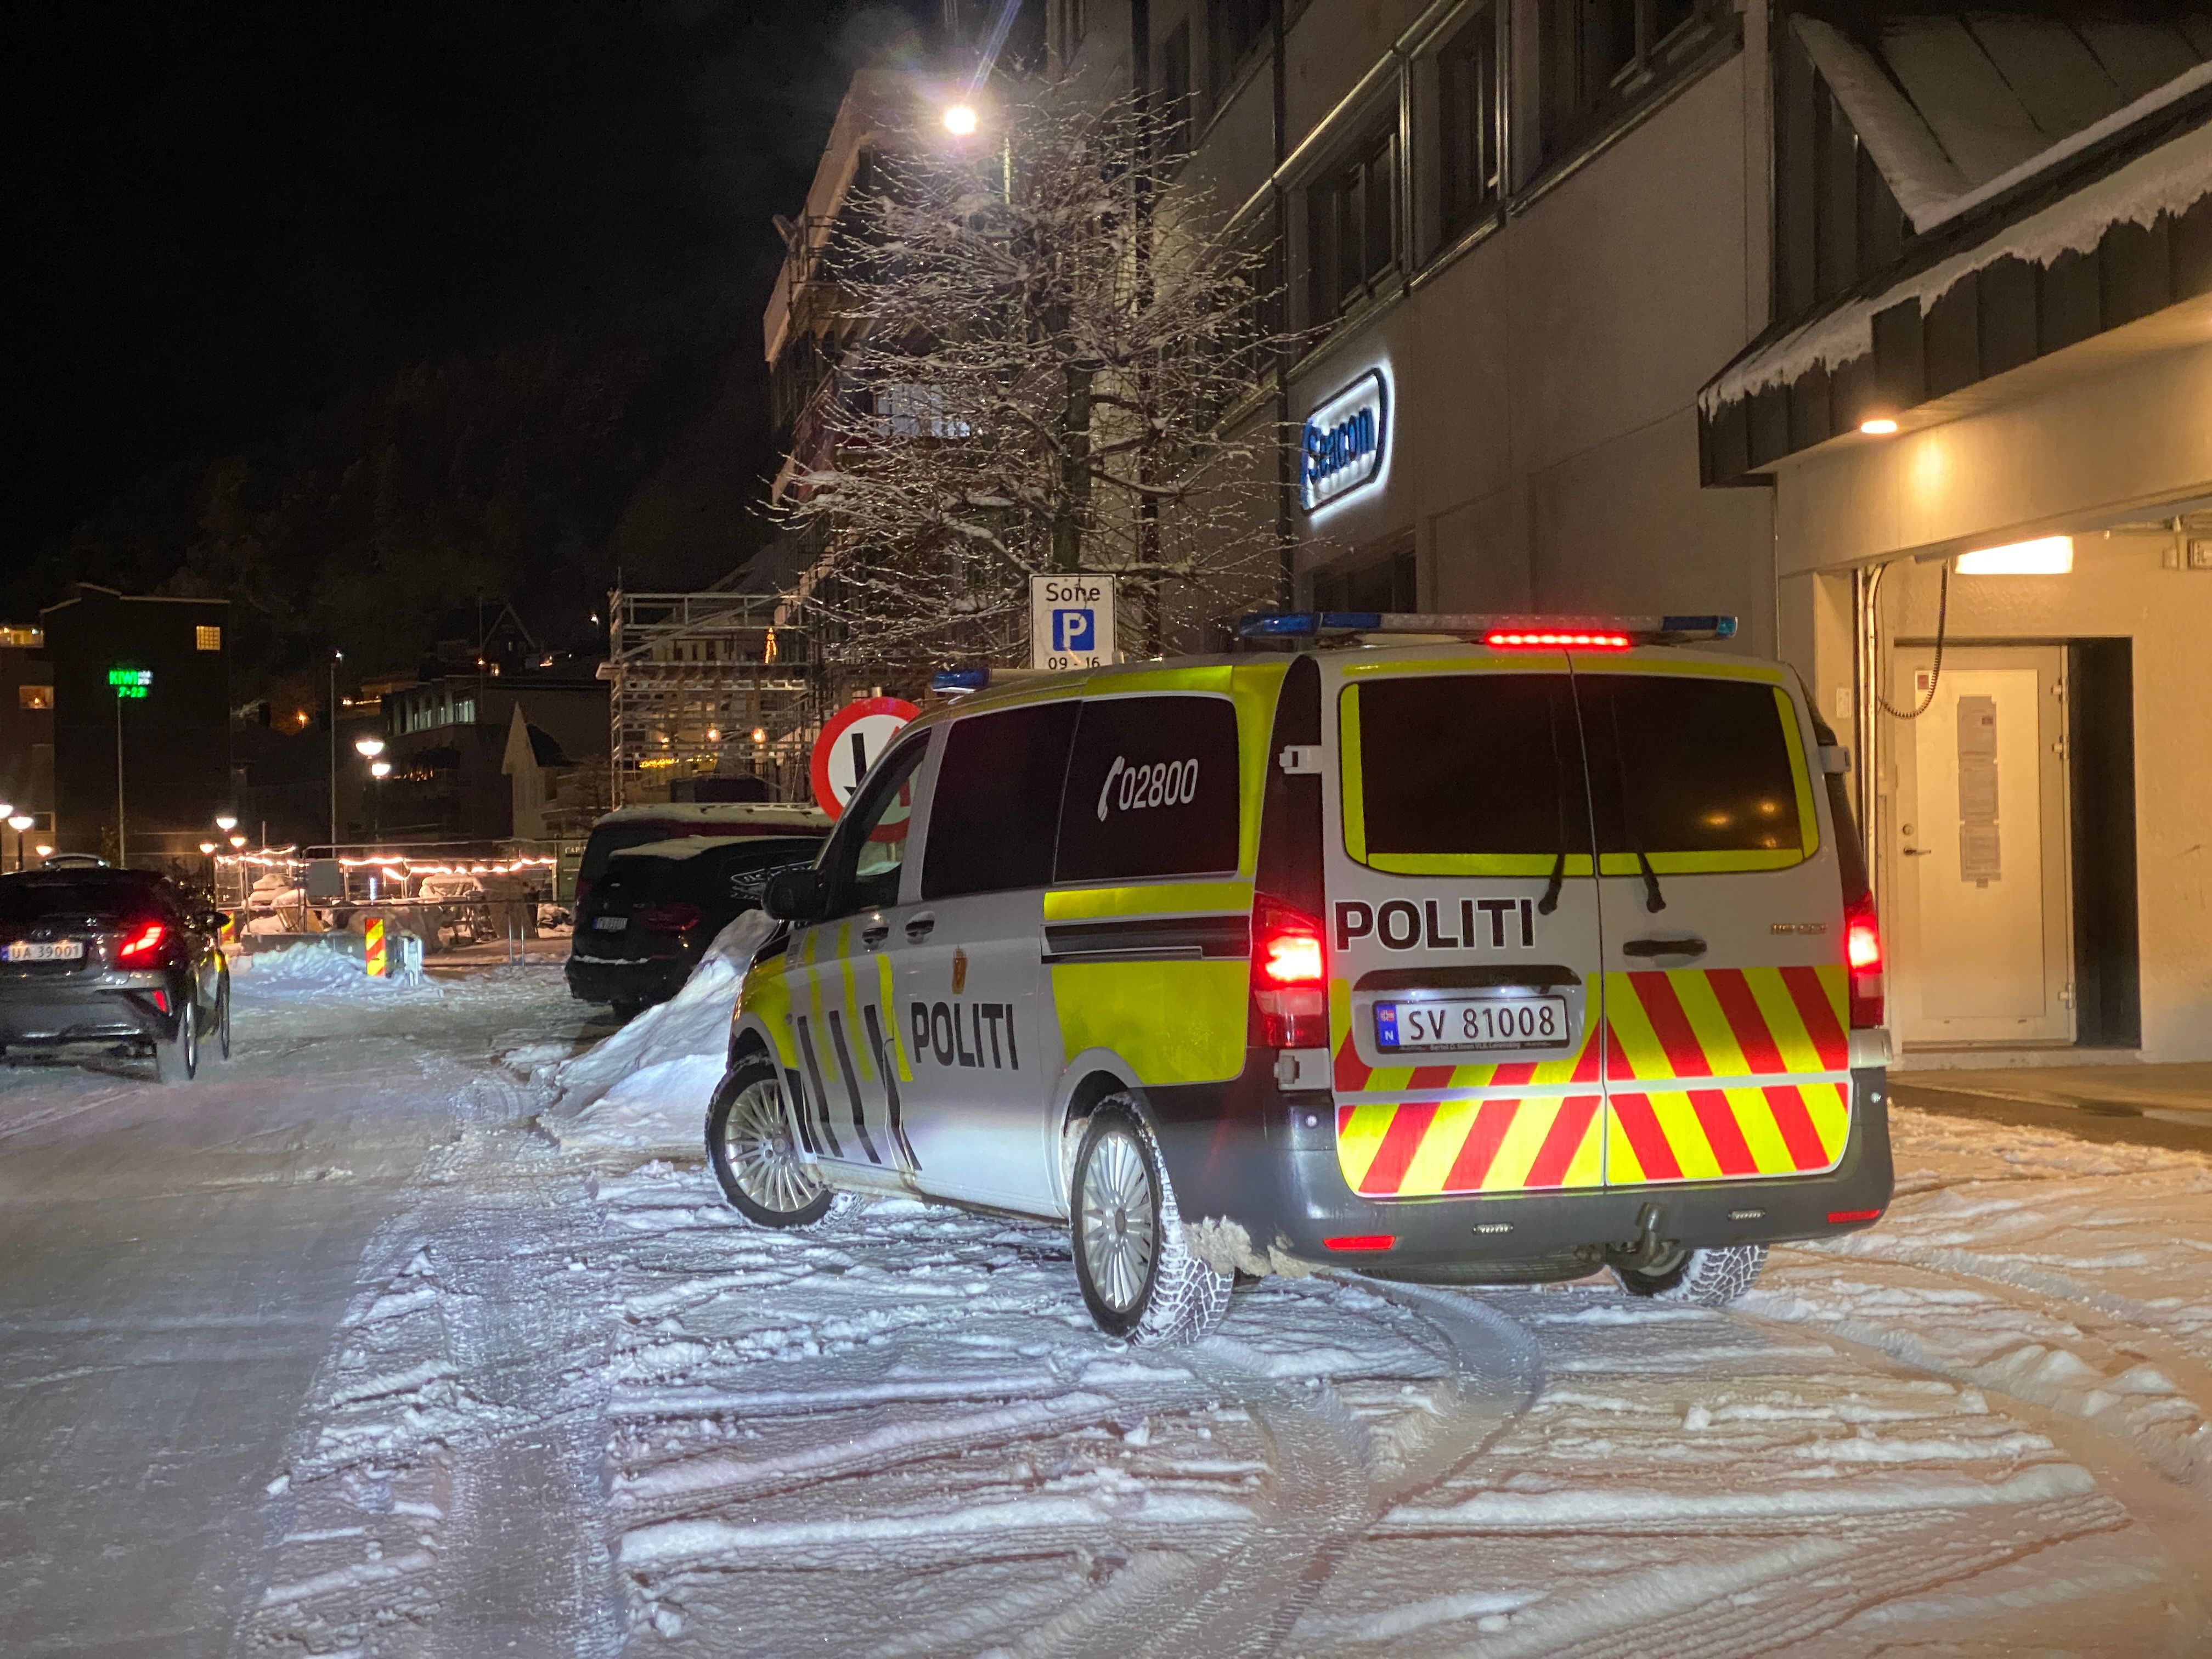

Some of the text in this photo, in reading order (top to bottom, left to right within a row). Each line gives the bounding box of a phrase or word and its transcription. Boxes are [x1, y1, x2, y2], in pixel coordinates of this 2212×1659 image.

[1046, 583, 1101, 602] Sone
[1063, 612, 1087, 650] P
[1048, 657, 1068, 670] 09
[1085, 657, 1101, 668] 16
[109, 670, 138, 685] KIWI
[1119, 758, 1199, 811] 02800
[1334, 897, 1536, 952] POLITI
[12, 945, 79, 959] UA 39001
[911, 1002, 1019, 1070] POLITI
[1384, 1030, 1394, 1041] N
[1408, 1006, 1555, 1040] SV 81008
